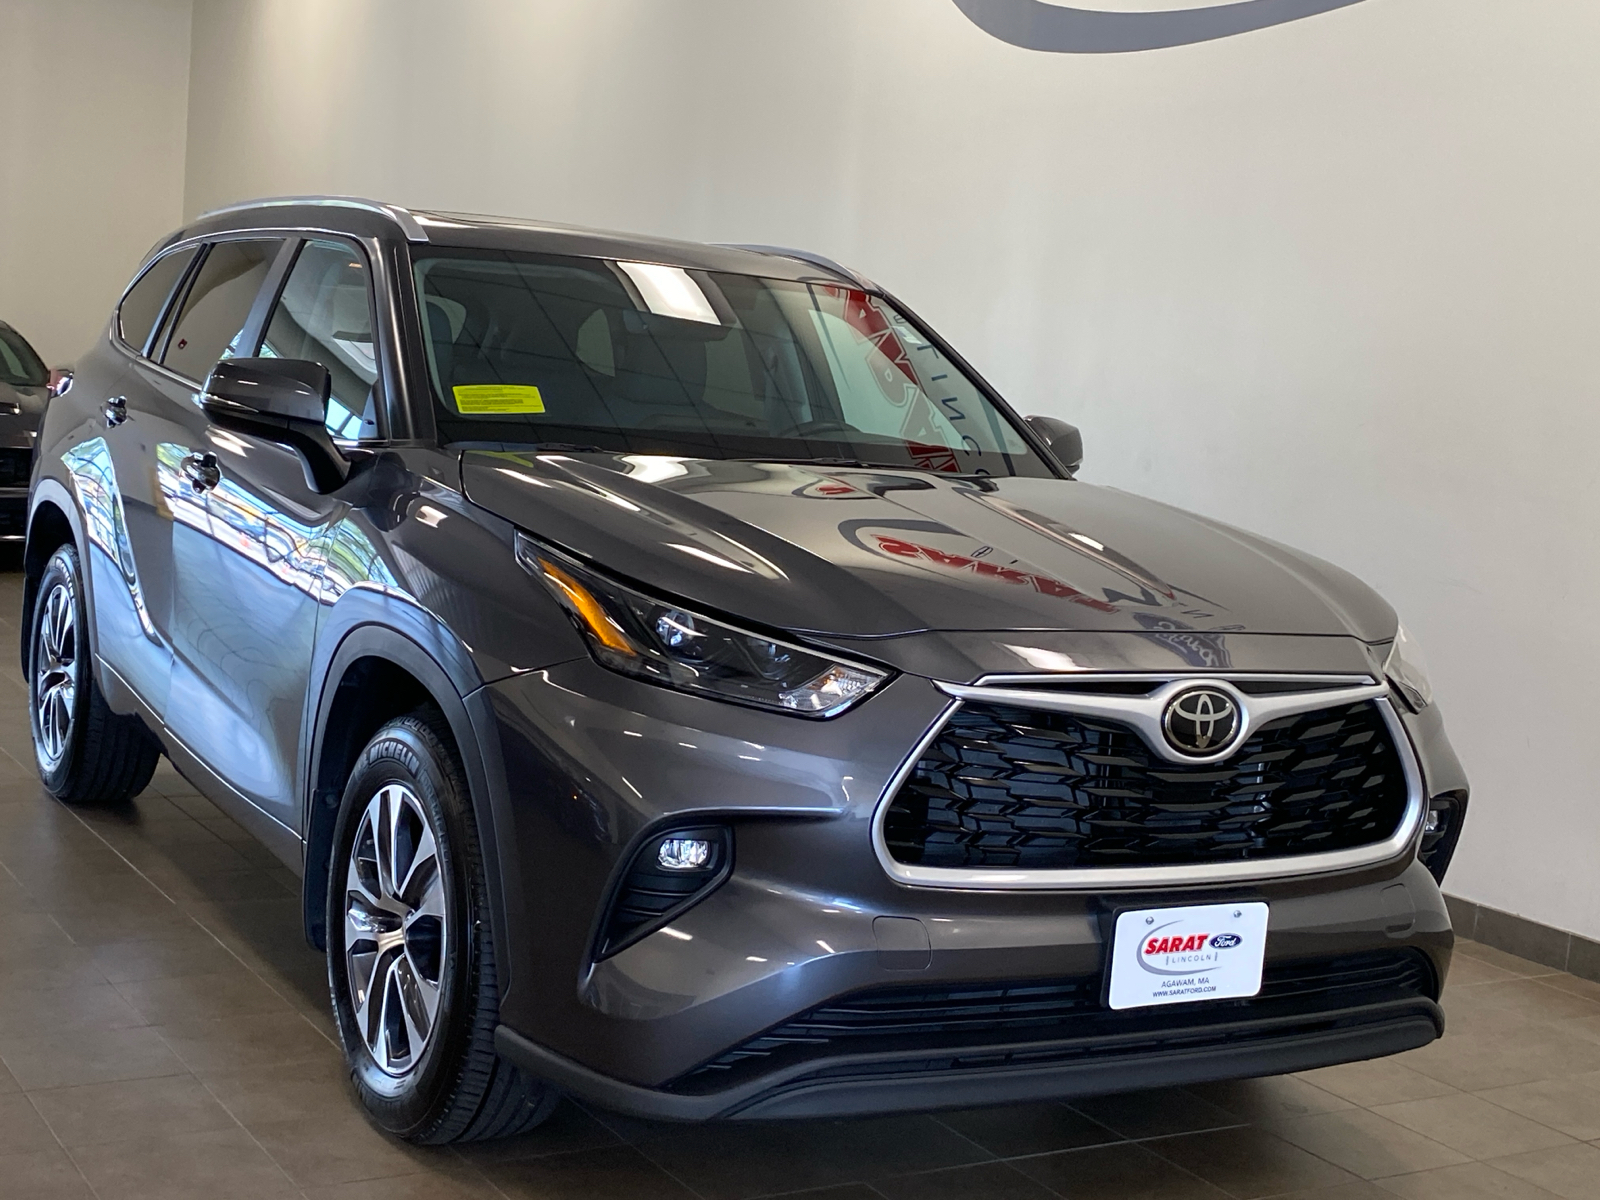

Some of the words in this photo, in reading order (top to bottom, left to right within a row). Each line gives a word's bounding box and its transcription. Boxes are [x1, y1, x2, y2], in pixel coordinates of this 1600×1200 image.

[369, 741, 420, 775] MICHELIN
[1143, 933, 1211, 955] SARAT
[1213, 934, 1238, 948] Ford
[1171, 954, 1212, 963] LINCOLN
[1161, 979, 1196, 988] AGAWAM,
[1197, 977, 1210, 985] MA
[1152, 986, 1217, 998] WWW.SARATFORD.COM
